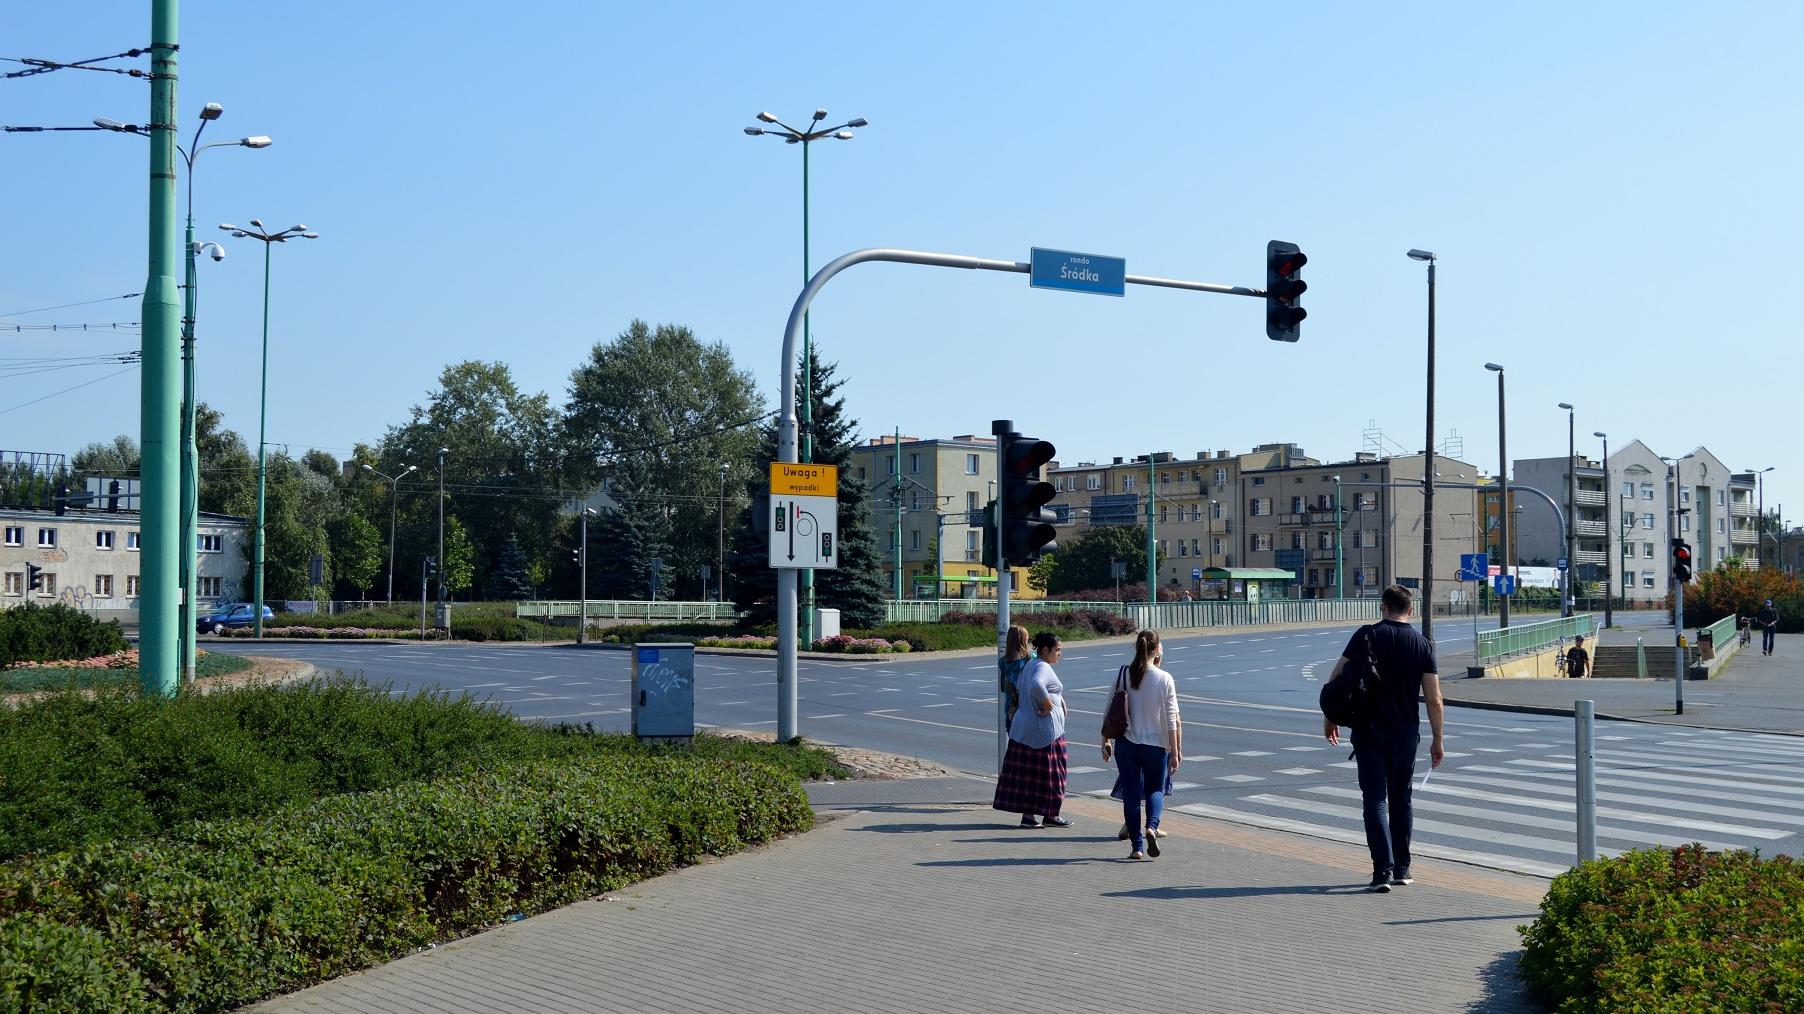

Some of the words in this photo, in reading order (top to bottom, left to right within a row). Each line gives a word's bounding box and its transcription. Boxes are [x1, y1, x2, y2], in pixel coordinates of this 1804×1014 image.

[1070, 256, 1090, 265] rondo
[1060, 262, 1100, 282] Śródka
[783, 467, 818, 480] Uwaga
[789, 484, 819, 492] wypadki
